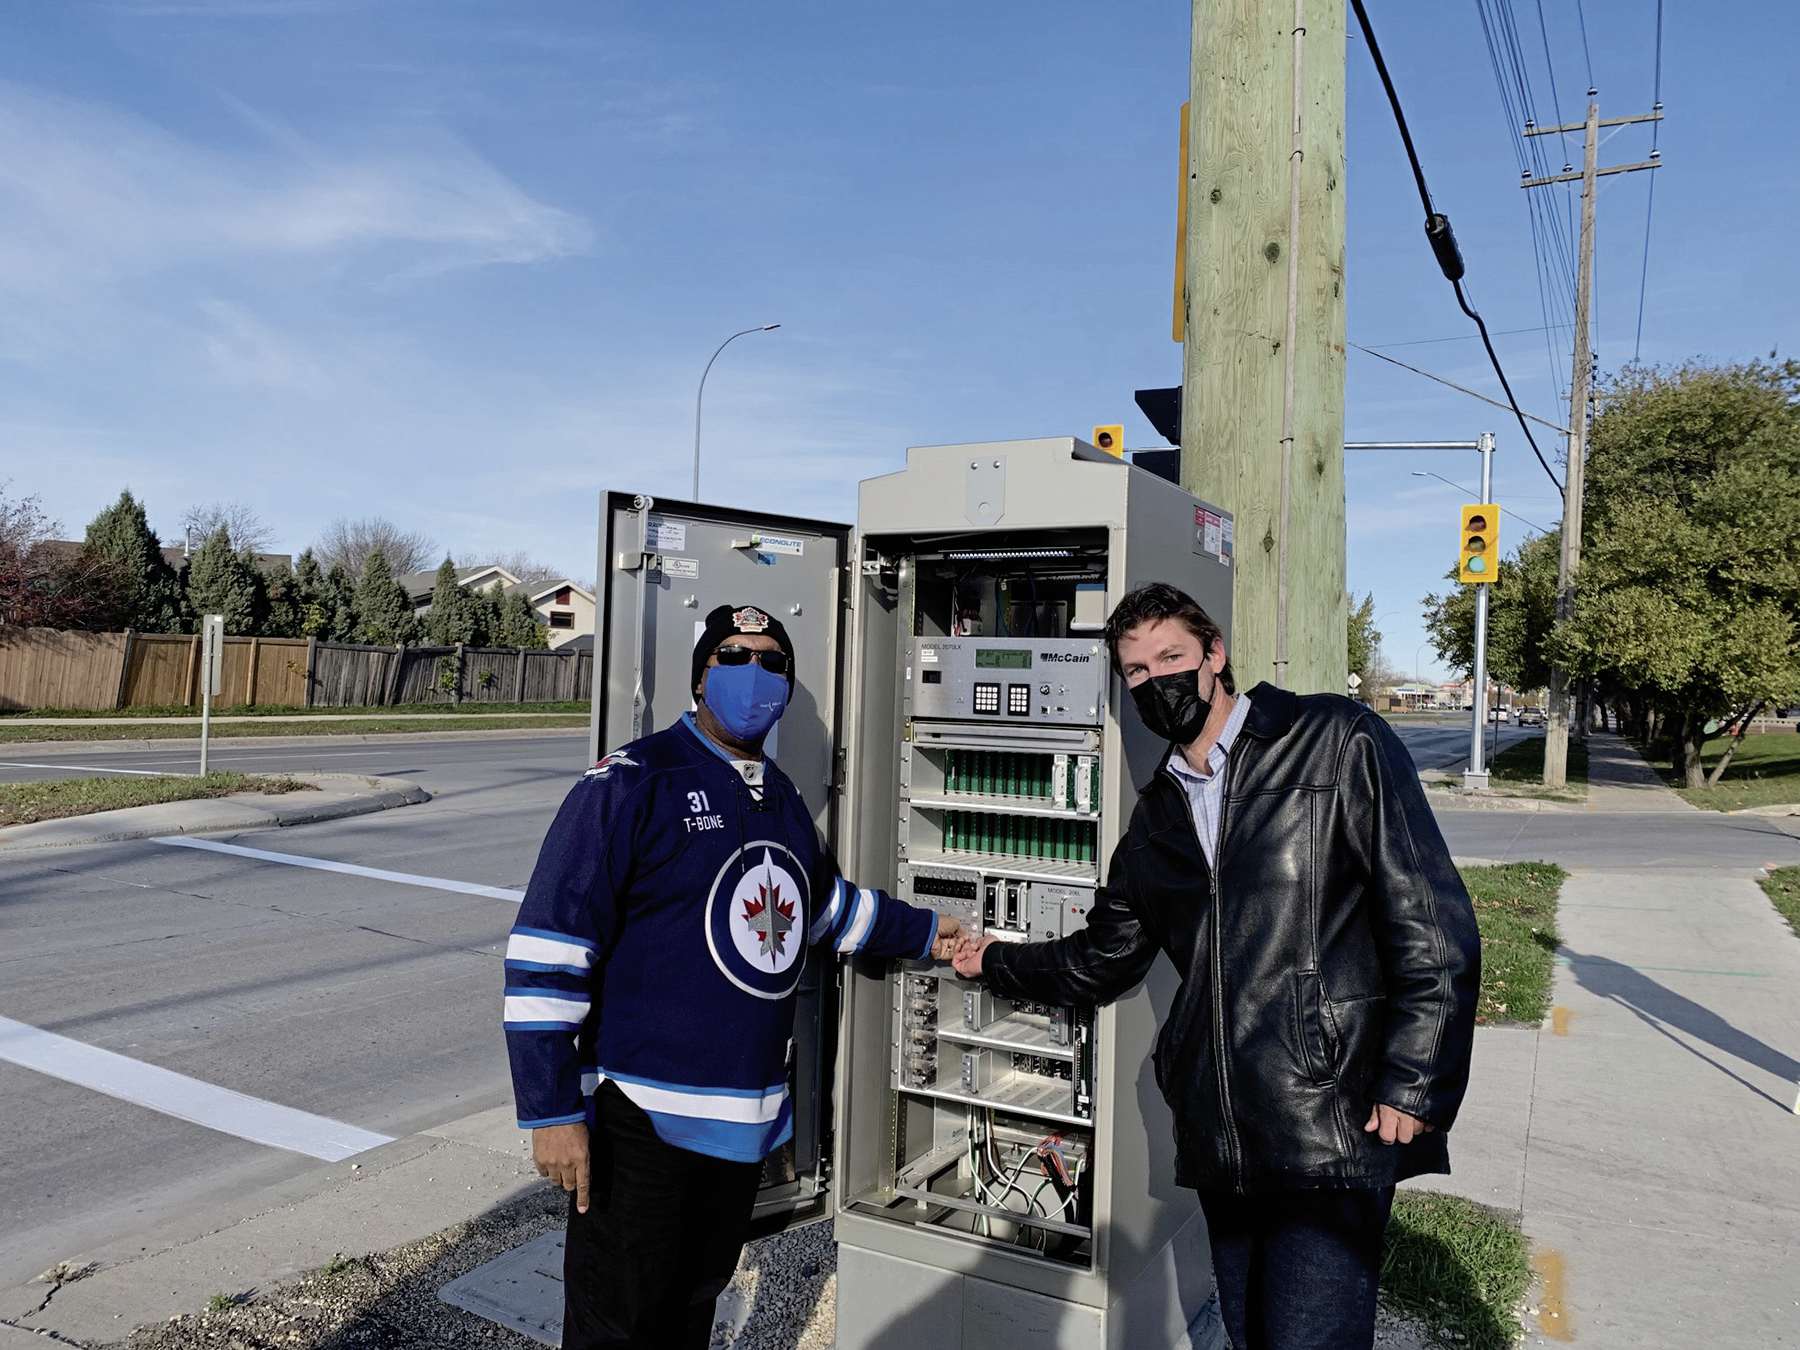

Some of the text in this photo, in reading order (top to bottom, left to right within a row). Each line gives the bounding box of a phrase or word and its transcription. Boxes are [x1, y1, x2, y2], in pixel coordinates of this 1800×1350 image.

[1048, 652, 1090, 663] McCain
[687, 790, 710, 813] 31
[683, 815, 725, 832] T-BONE
